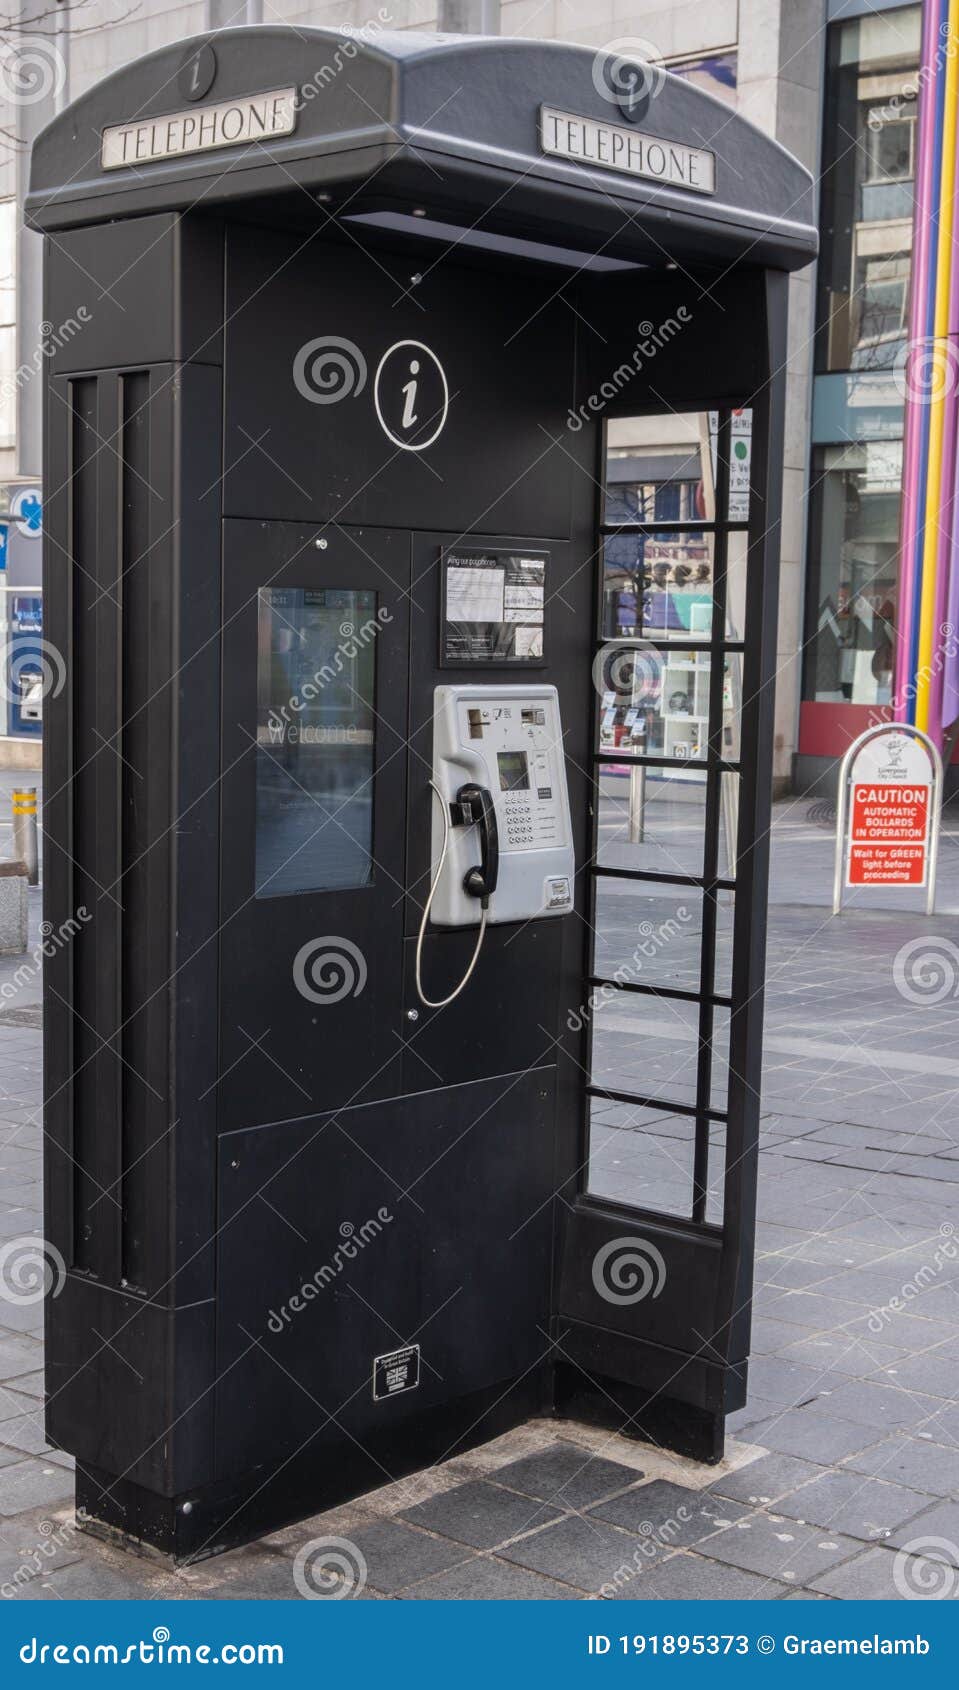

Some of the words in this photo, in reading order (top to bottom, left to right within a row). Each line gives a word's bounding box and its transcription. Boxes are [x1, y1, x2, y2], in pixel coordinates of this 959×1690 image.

[118, 96, 286, 162] TELEPHONE
[547, 114, 700, 187] TELEPHONE
[267, 718, 357, 744] Welcome
[856, 788, 925, 804] CAUTION
[863, 807, 917, 817] AUTOMATIC
[865, 817, 914, 827] BOLLARDS
[856, 828, 867, 837] IN
[869, 828, 922, 838] OPERATION
[853, 848, 873, 859] Wait
[875, 848, 888, 859] for
[890, 848, 922, 858] GREEN
[862, 859, 882, 870] light
[883, 859, 912, 869] before
[863, 869, 910, 881] proceeding
